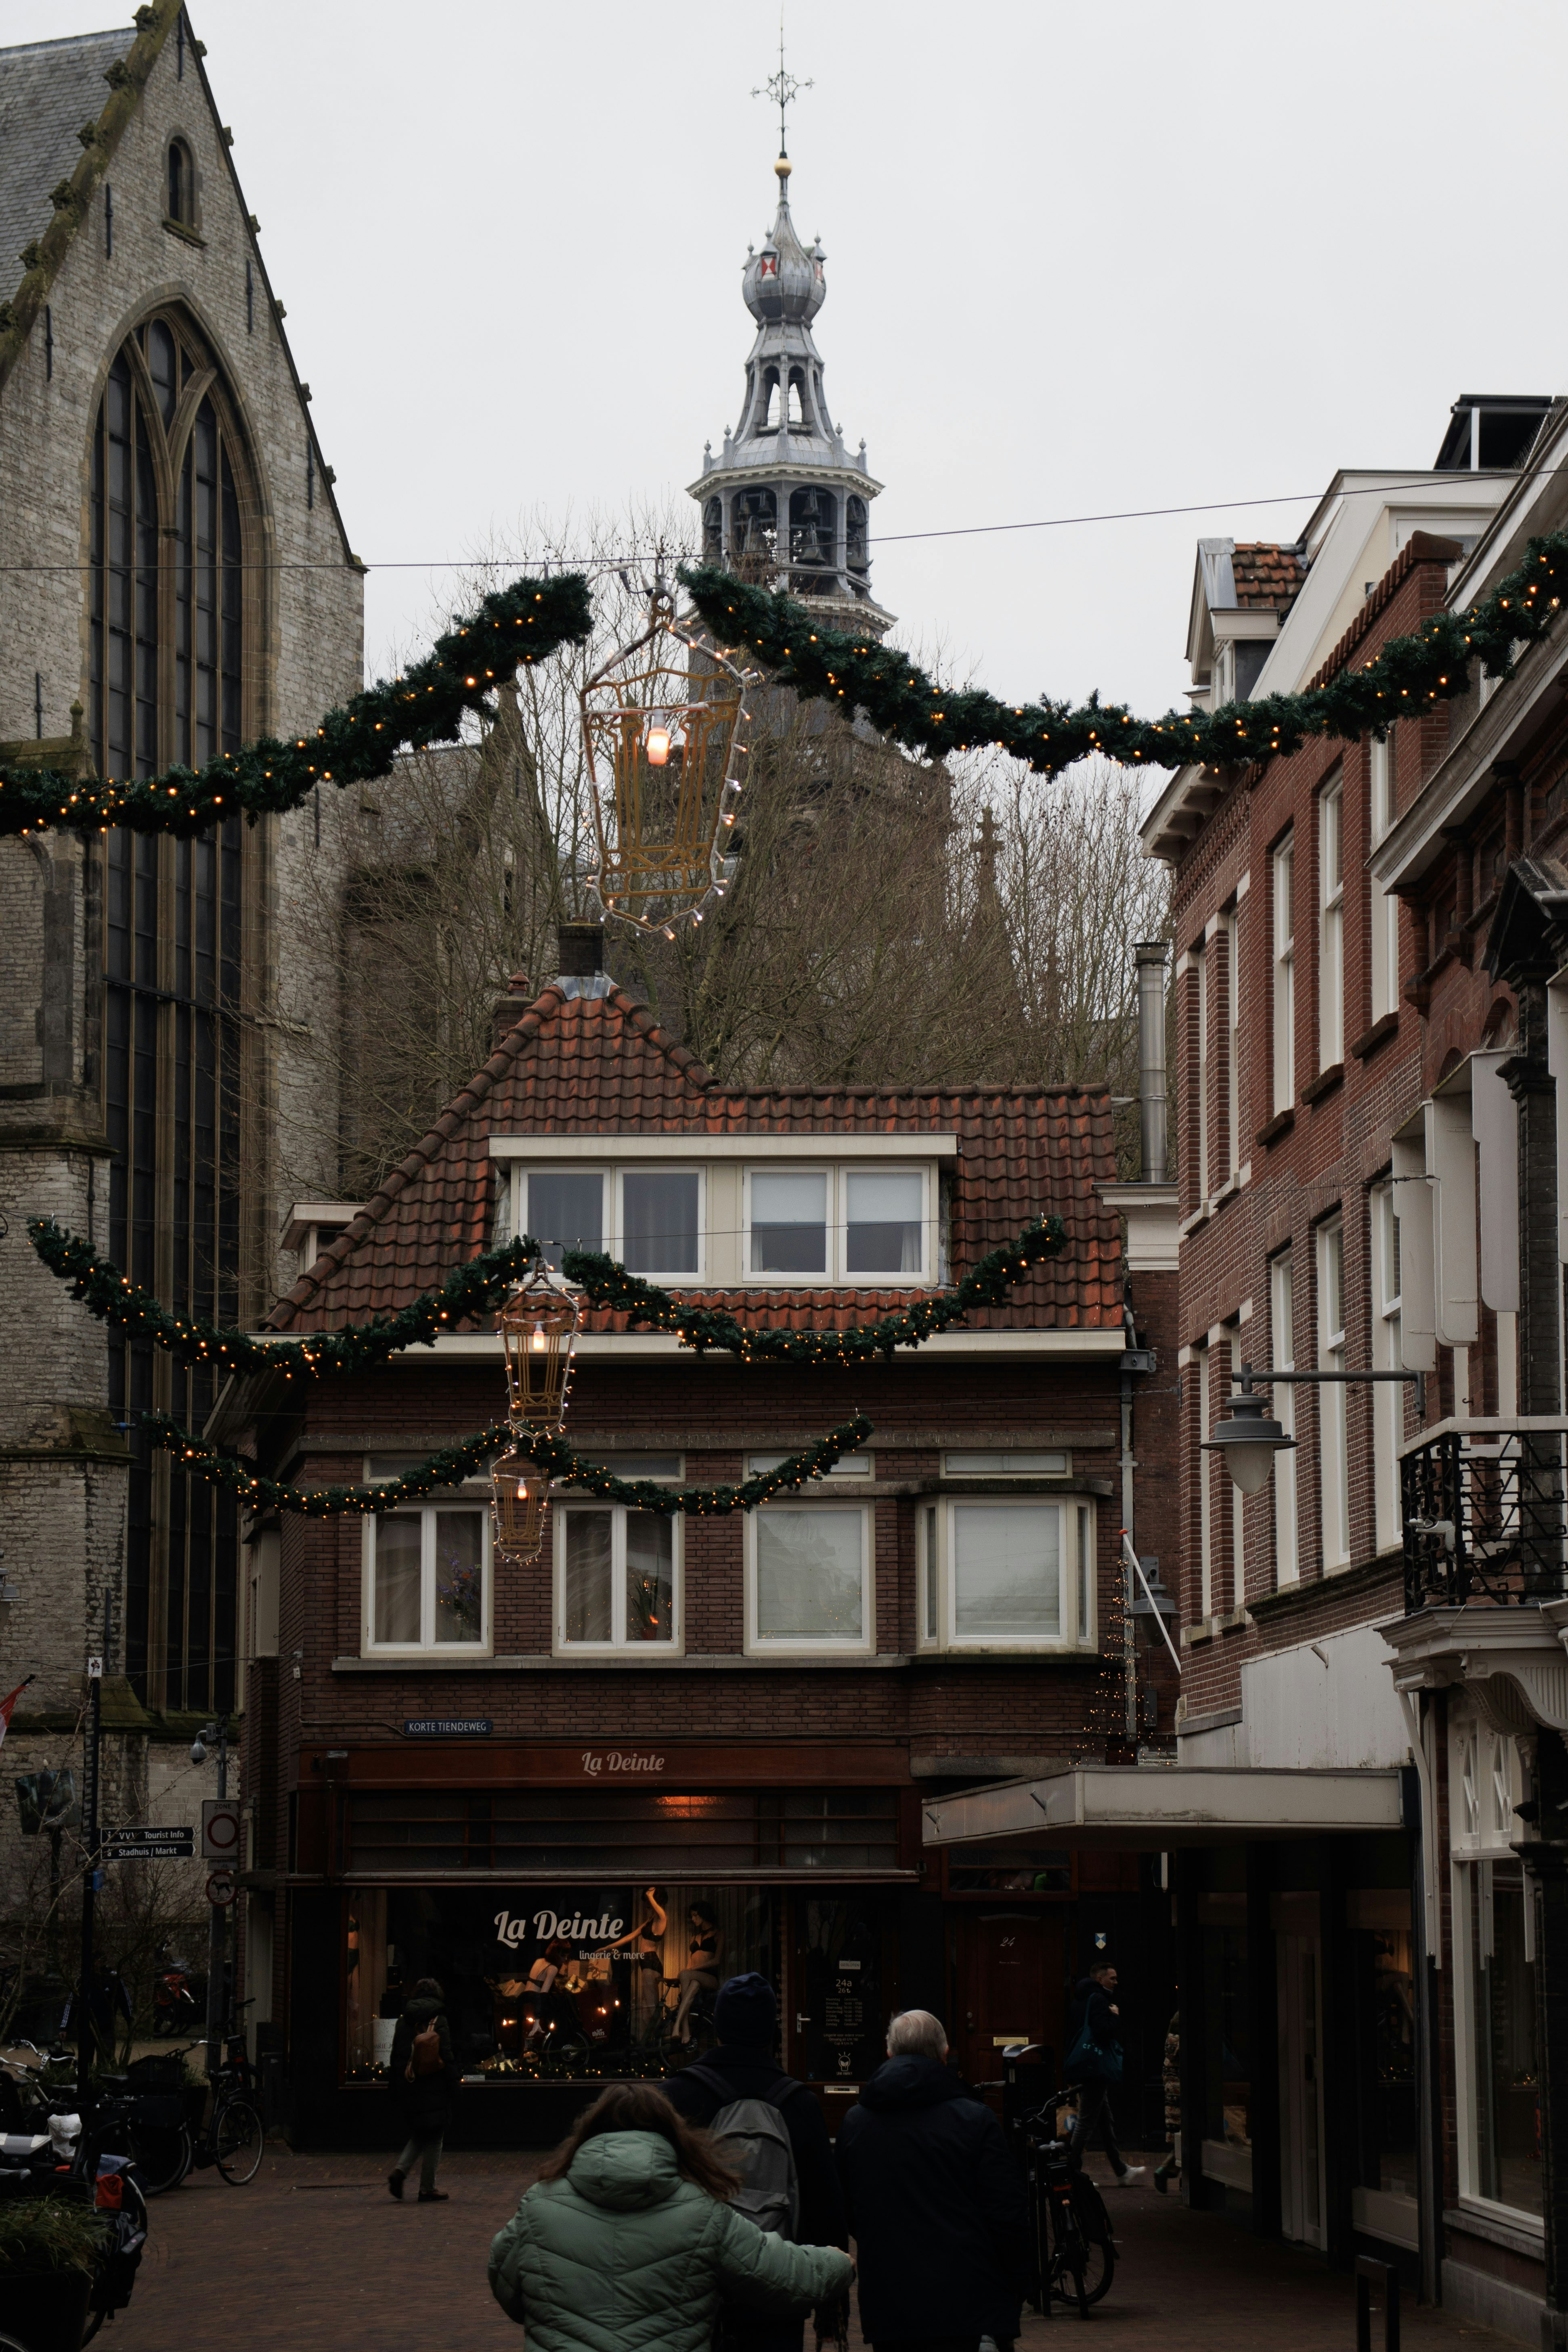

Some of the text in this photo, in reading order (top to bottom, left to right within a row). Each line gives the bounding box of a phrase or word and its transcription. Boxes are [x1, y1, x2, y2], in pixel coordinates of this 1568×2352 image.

[409, 1722, 486, 1731] KORTE TIENDEWEG
[581, 1752, 665, 1776] La Deinte
[170, 1830, 184, 1838] Info
[118, 1848, 149, 1856] Stadhuis
[155, 1847, 177, 1855] Markt
[494, 1910, 624, 1949] La Deinte
[1000, 1937, 1016, 1946] 24
[579, 1950, 610, 1960] lingerie
[612, 1949, 621, 1960] &
[836, 1979, 852, 1987] 24a
